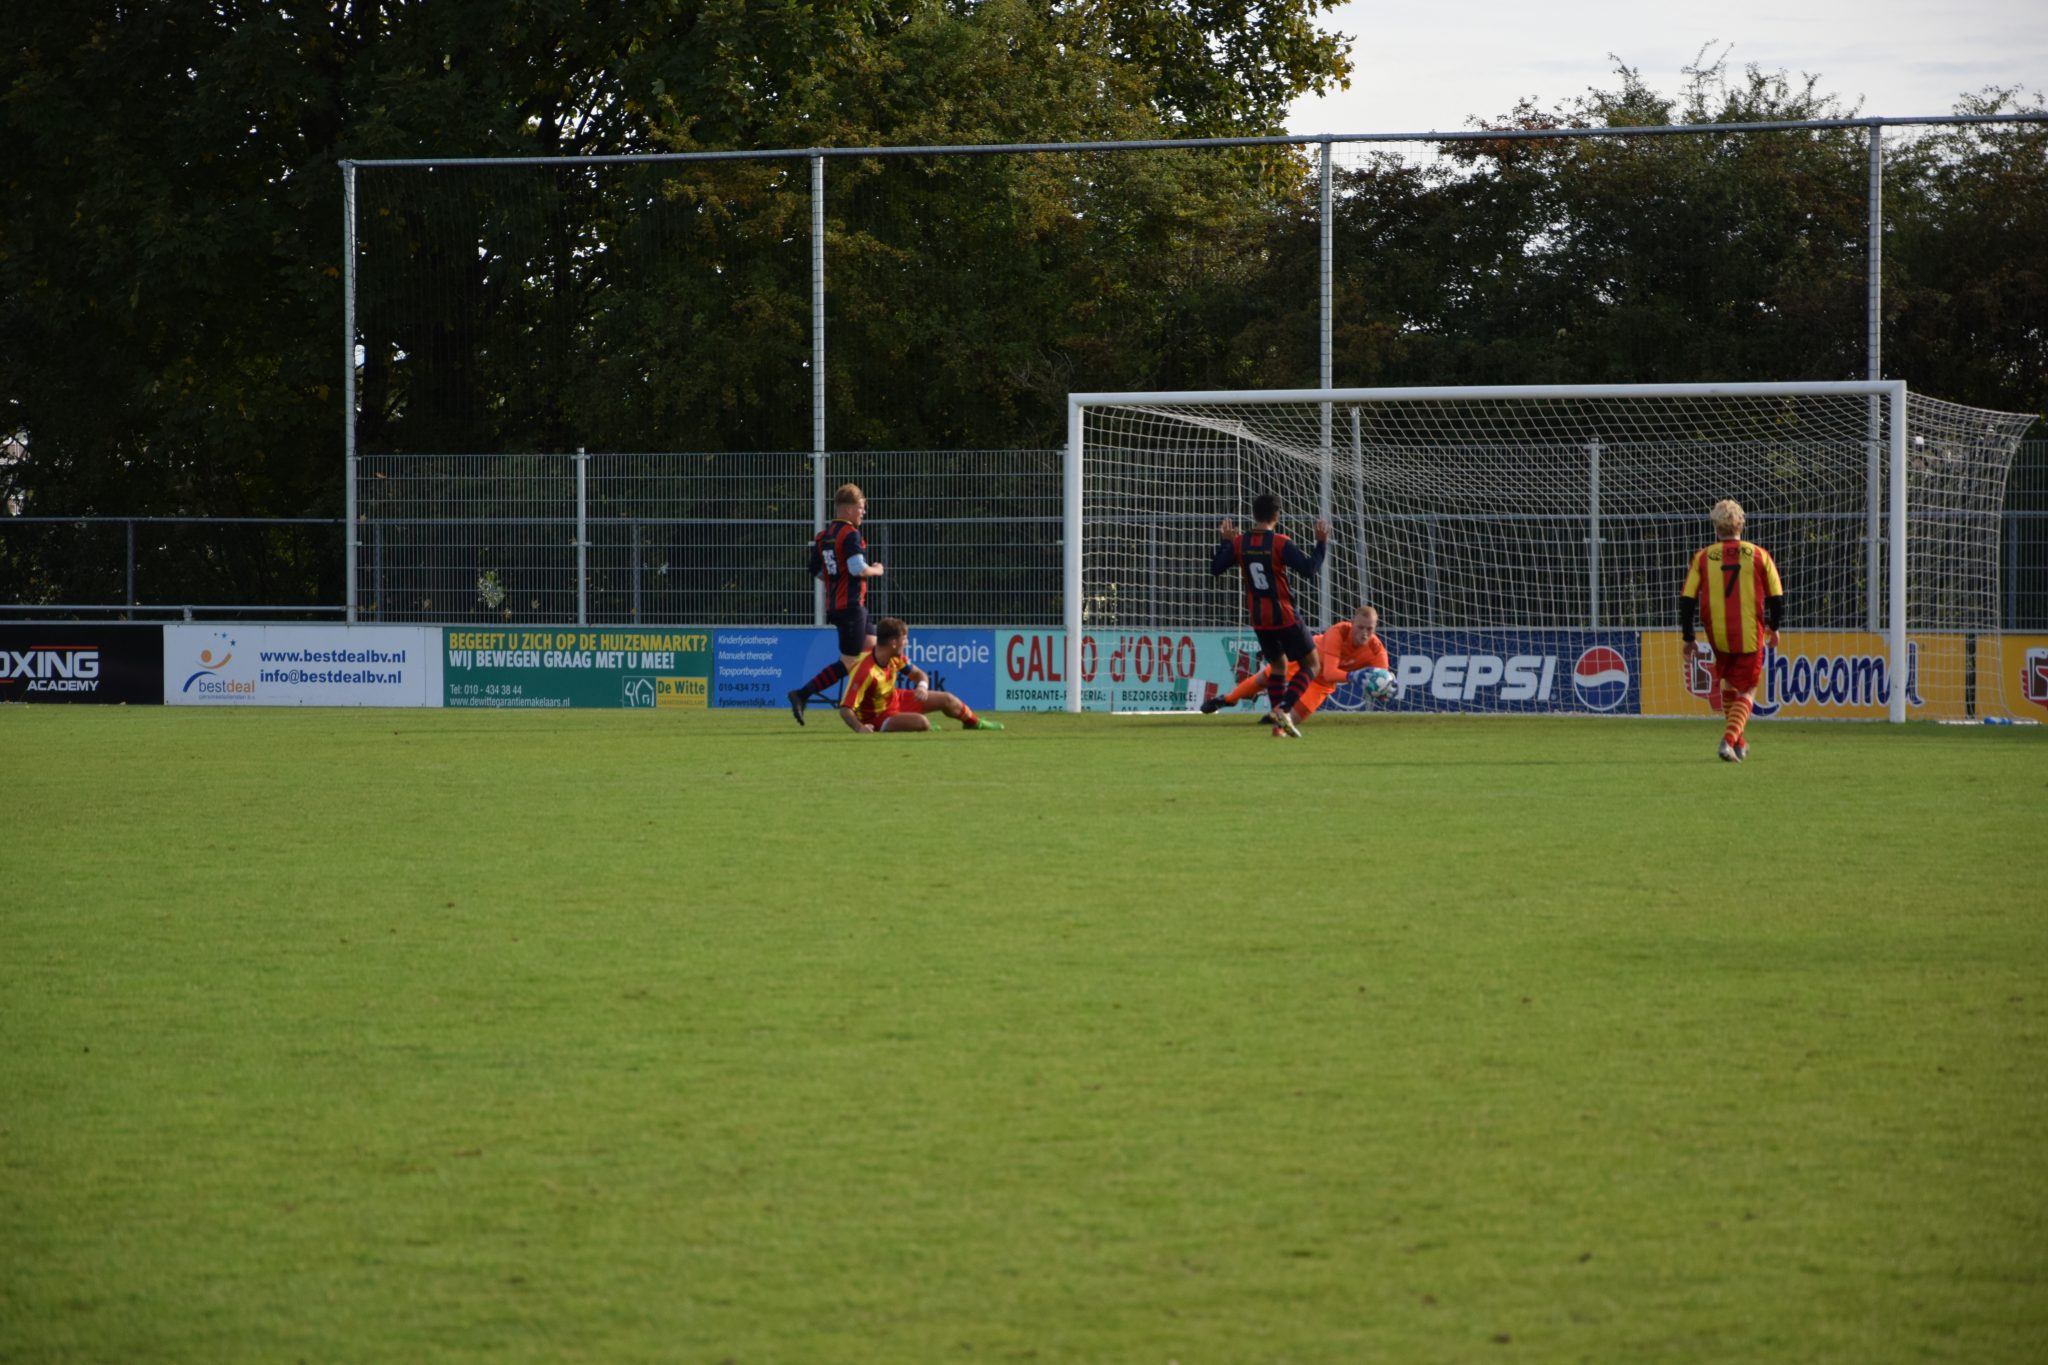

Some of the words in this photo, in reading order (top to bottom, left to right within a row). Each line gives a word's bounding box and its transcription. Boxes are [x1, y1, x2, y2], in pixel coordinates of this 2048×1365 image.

[1249, 562, 1269, 590] 6
[1720, 564, 1742, 599] 7
[449, 633, 505, 650] BEGEEFT
[508, 633, 519, 650] U
[522, 633, 552, 650] ZICH
[555, 633, 577, 650] OP
[579, 634, 597, 650] DE
[600, 634, 708, 652] HUIZENMARKT?
[1228, 640, 1262, 652] PIZZER
[260, 649, 406, 663] www.bestdealbv.nl
[448, 650, 472, 670] WIJ
[476, 651, 541, 667] BEWEGEN
[543, 651, 592, 668] GRAAG
[595, 652, 624, 668] MET
[627, 652, 638, 669] U
[641, 652, 675, 669] MEE!
[1006, 634, 1098, 682] GALO
[1110, 635, 1196, 682] d'ORO
[260, 669, 402, 684] info@bestdealbv.nl
[1397, 655, 1556, 700] PEPSI
[1751, 642, 1924, 716] hocoml
[27, 680, 99, 691] ACADEMY
[199, 680, 256, 693] bestdeal
[464, 684, 479, 695] 010
[485, 684, 499, 695] 434
[501, 684, 511, 695] 38
[512, 684, 522, 695] 44
[657, 681, 672, 694] De
[675, 680, 705, 694] Witte
